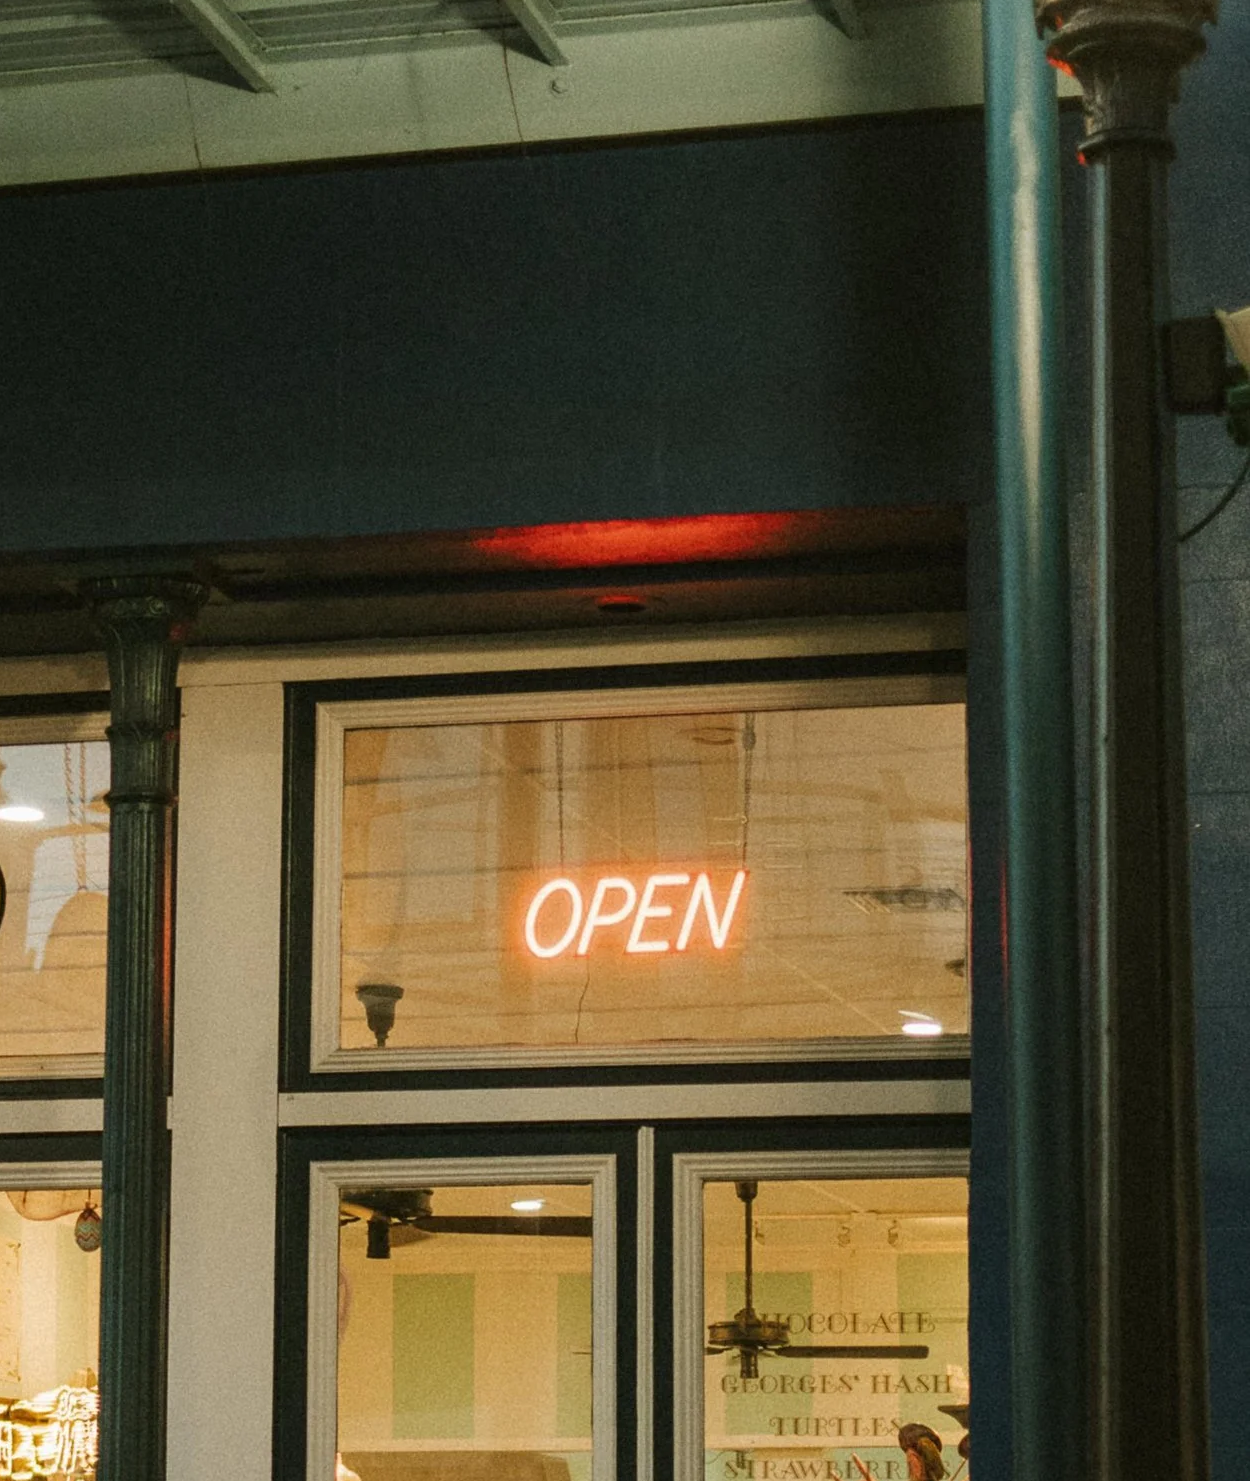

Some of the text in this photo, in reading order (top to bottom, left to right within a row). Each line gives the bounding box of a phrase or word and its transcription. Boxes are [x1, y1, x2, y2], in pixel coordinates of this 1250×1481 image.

[525, 870, 746, 958] OPEN
[755, 1311, 936, 1335] HOCOLATE
[871, 1374, 955, 1395] HASH
[769, 1416, 903, 1437] TURTLES
[724, 1459, 951, 1480] STRAWBERRS
